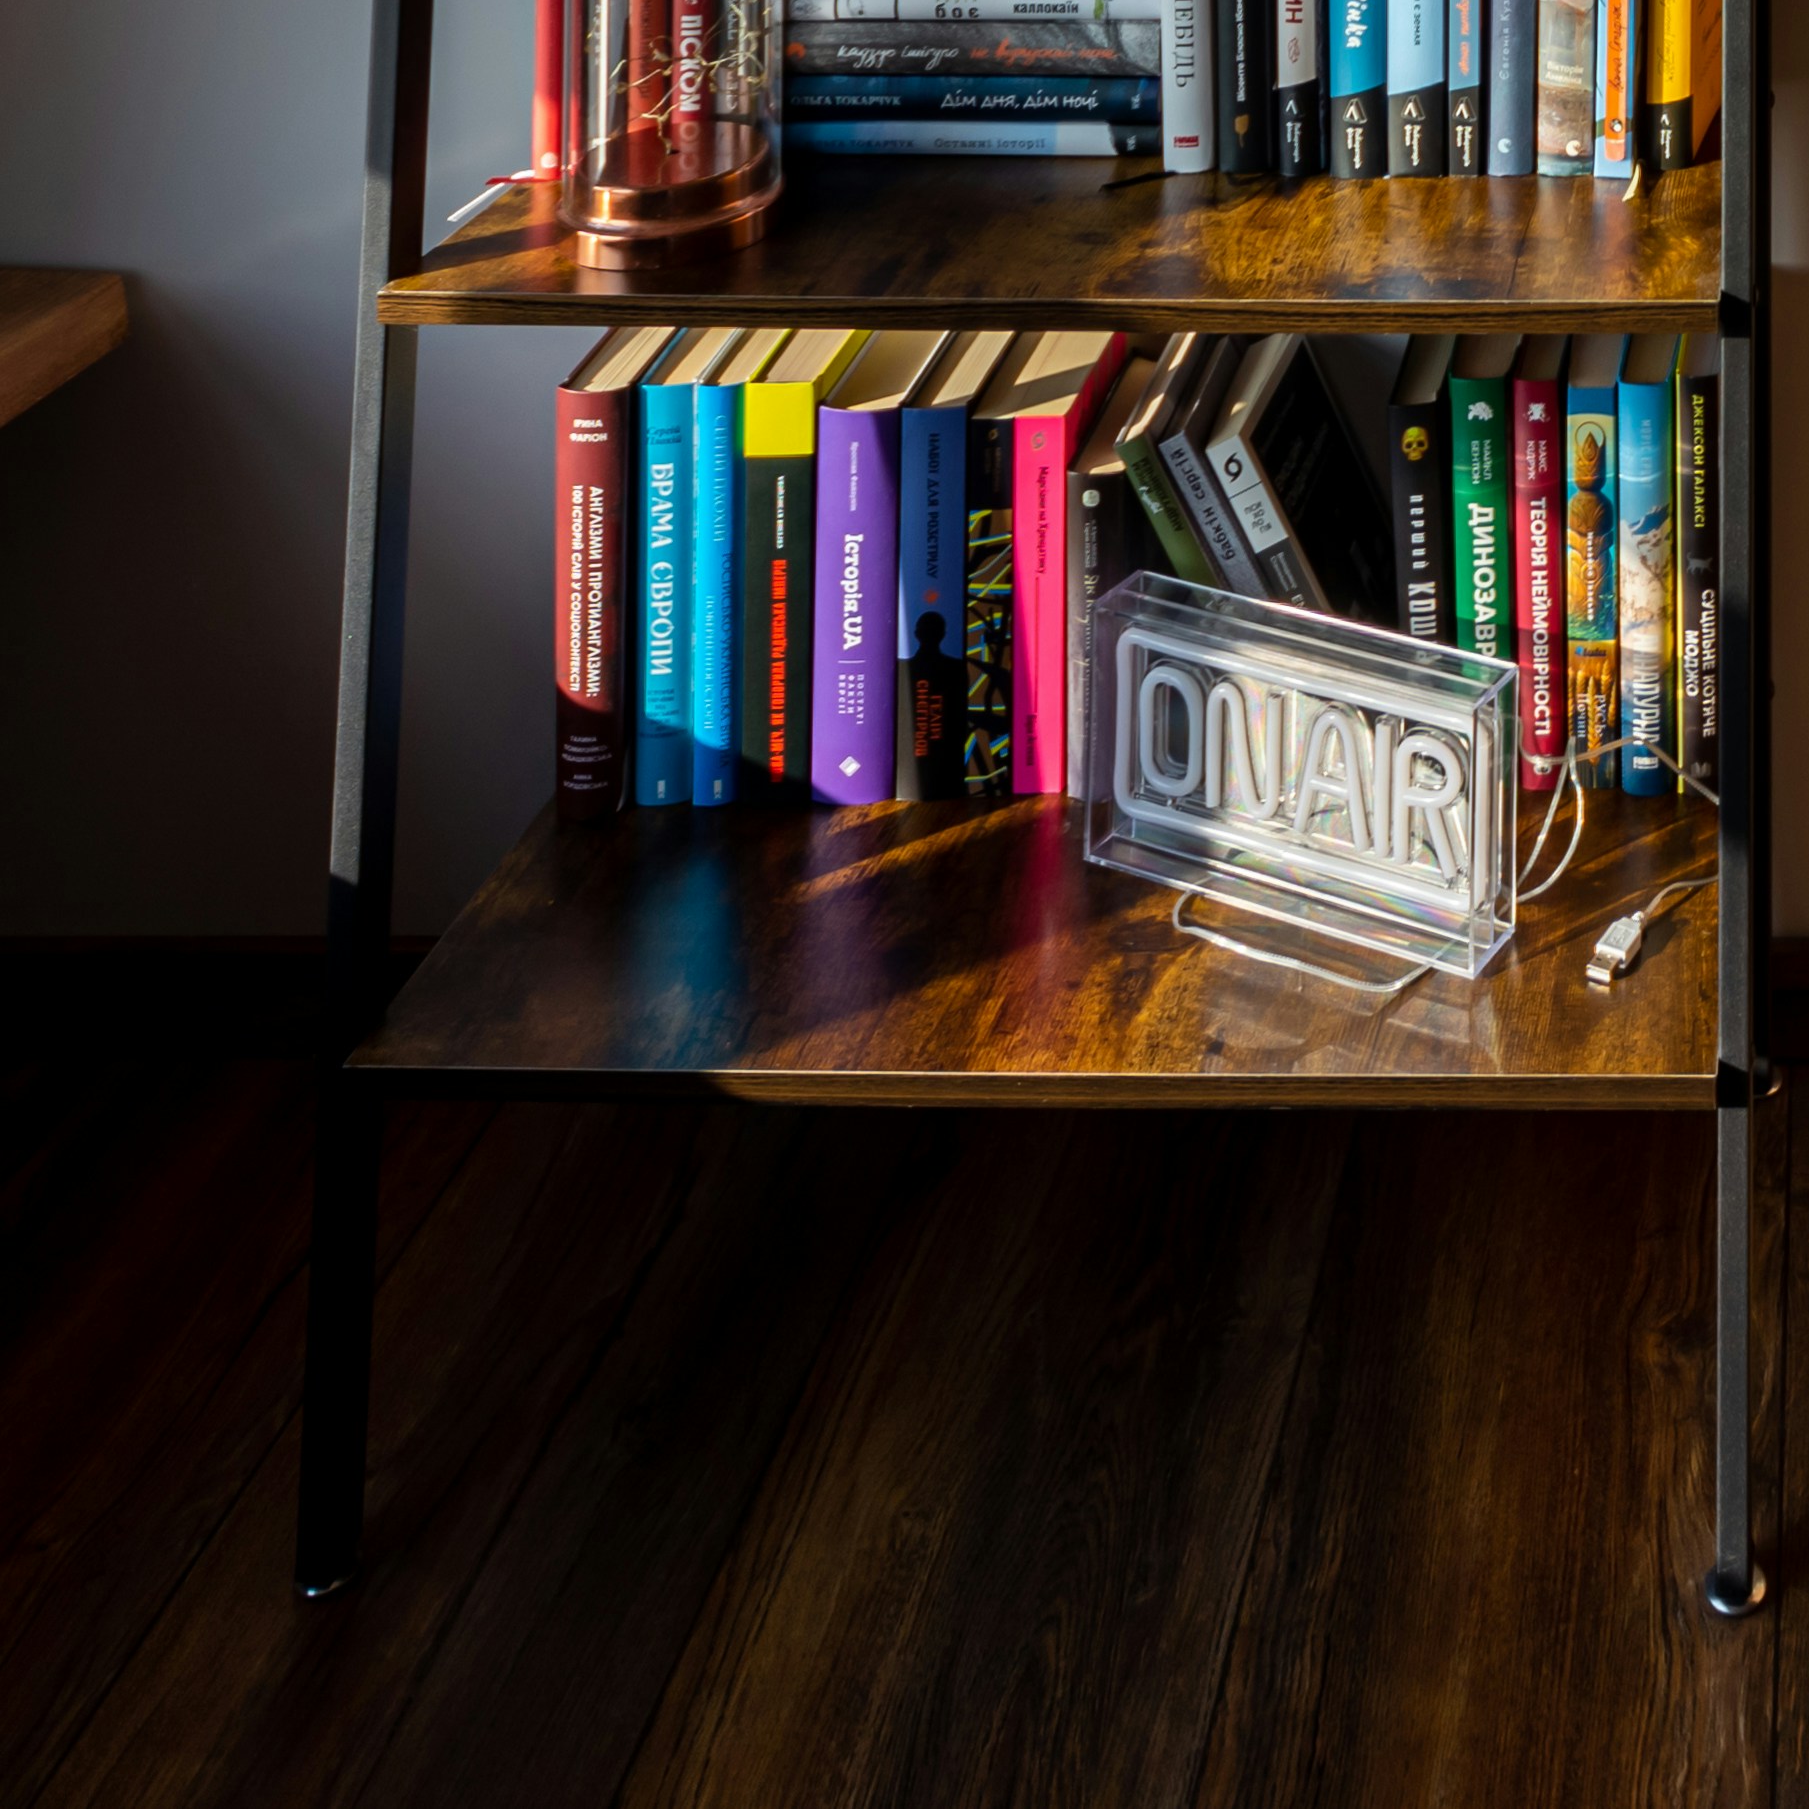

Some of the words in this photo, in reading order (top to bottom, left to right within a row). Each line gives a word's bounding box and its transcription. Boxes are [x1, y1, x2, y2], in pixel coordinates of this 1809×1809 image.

[1013, 1, 1079, 14] каллокаїн
[934, 137, 992, 149] Останні
[996, 138, 1046, 149] історії
[569, 432, 608, 442] ФАРІОН
[573, 418, 604, 428] ІРИНА
[1692, 394, 1704, 465] ДЖЕКСОН
[928, 432, 940, 474] НАБОЇ
[1471, 439, 1481, 485] БЕНТОН
[1483, 439, 1493, 481] МАЙКЛ
[1527, 440, 1536, 480] КІДРУК
[1538, 440, 1547, 472] МАКС
[571, 485, 584, 504] 100
[650, 462, 674, 549] БРАМА
[927, 478, 939, 507] ДЛЯ
[1693, 469, 1705, 528] ГАЛАКСІ
[571, 505, 585, 550] ІСТОРІЙ
[926, 511, 939, 579] РОЗСТРІЛУ
[1530, 496, 1547, 567] ТЕОРІЯ
[571, 552, 583, 580] СЛІВ
[571, 581, 582, 591] У
[649, 560, 675, 675] ЄВРОПИ
[1701, 589, 1716, 670] СУЦІЛЬНЕ
[1531, 569, 1552, 736] НЕЙМОВІРНОСТІ
[1684, 630, 1699, 697] МОДЖО
[847, 674, 855, 714] ФАКТИ
[856, 674, 865, 725] ПОСТАТІ
[1702, 675, 1715, 738] КОТЯЧЕ
